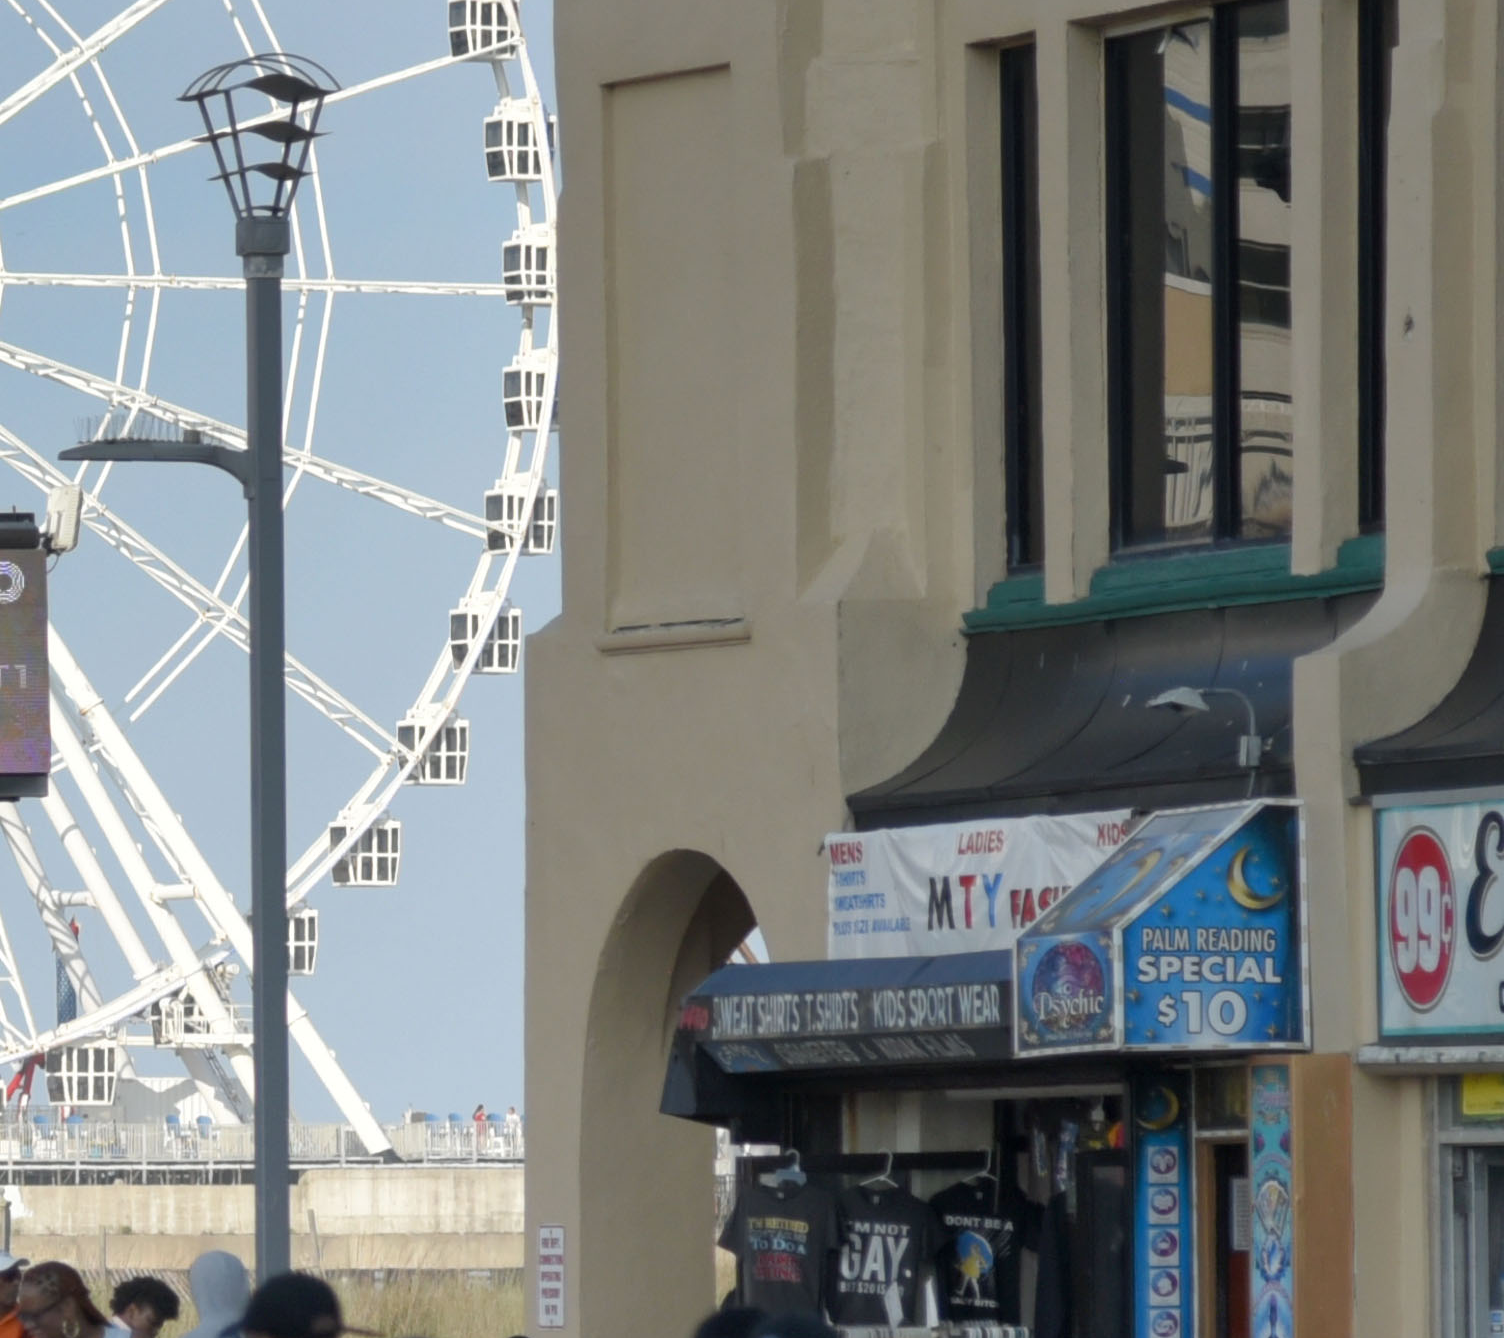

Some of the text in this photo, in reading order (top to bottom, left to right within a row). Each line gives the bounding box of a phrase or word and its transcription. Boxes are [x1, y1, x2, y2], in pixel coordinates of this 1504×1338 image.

[13, 664, 29, 689] 1
[829, 841, 864, 866] MENS
[957, 829, 1005, 856] LADIES
[1394, 865, 1453, 974] 99¢
[1141, 927, 1277, 953] PALM READING
[1136, 954, 1283, 984] SPECIAL
[757, 996, 801, 1035] SHIRTS
[872, 990, 906, 1029] KIDS
[908, 987, 954, 1027] SPORT
[957, 984, 1001, 1025] WEAR
[1033, 988, 1104, 1029] Psychic
[1156, 989, 1248, 1035] $10
[874, 1222, 911, 1237] NOT
[983, 1217, 1001, 1229] BE
[1005, 1219, 1014, 1232] A
